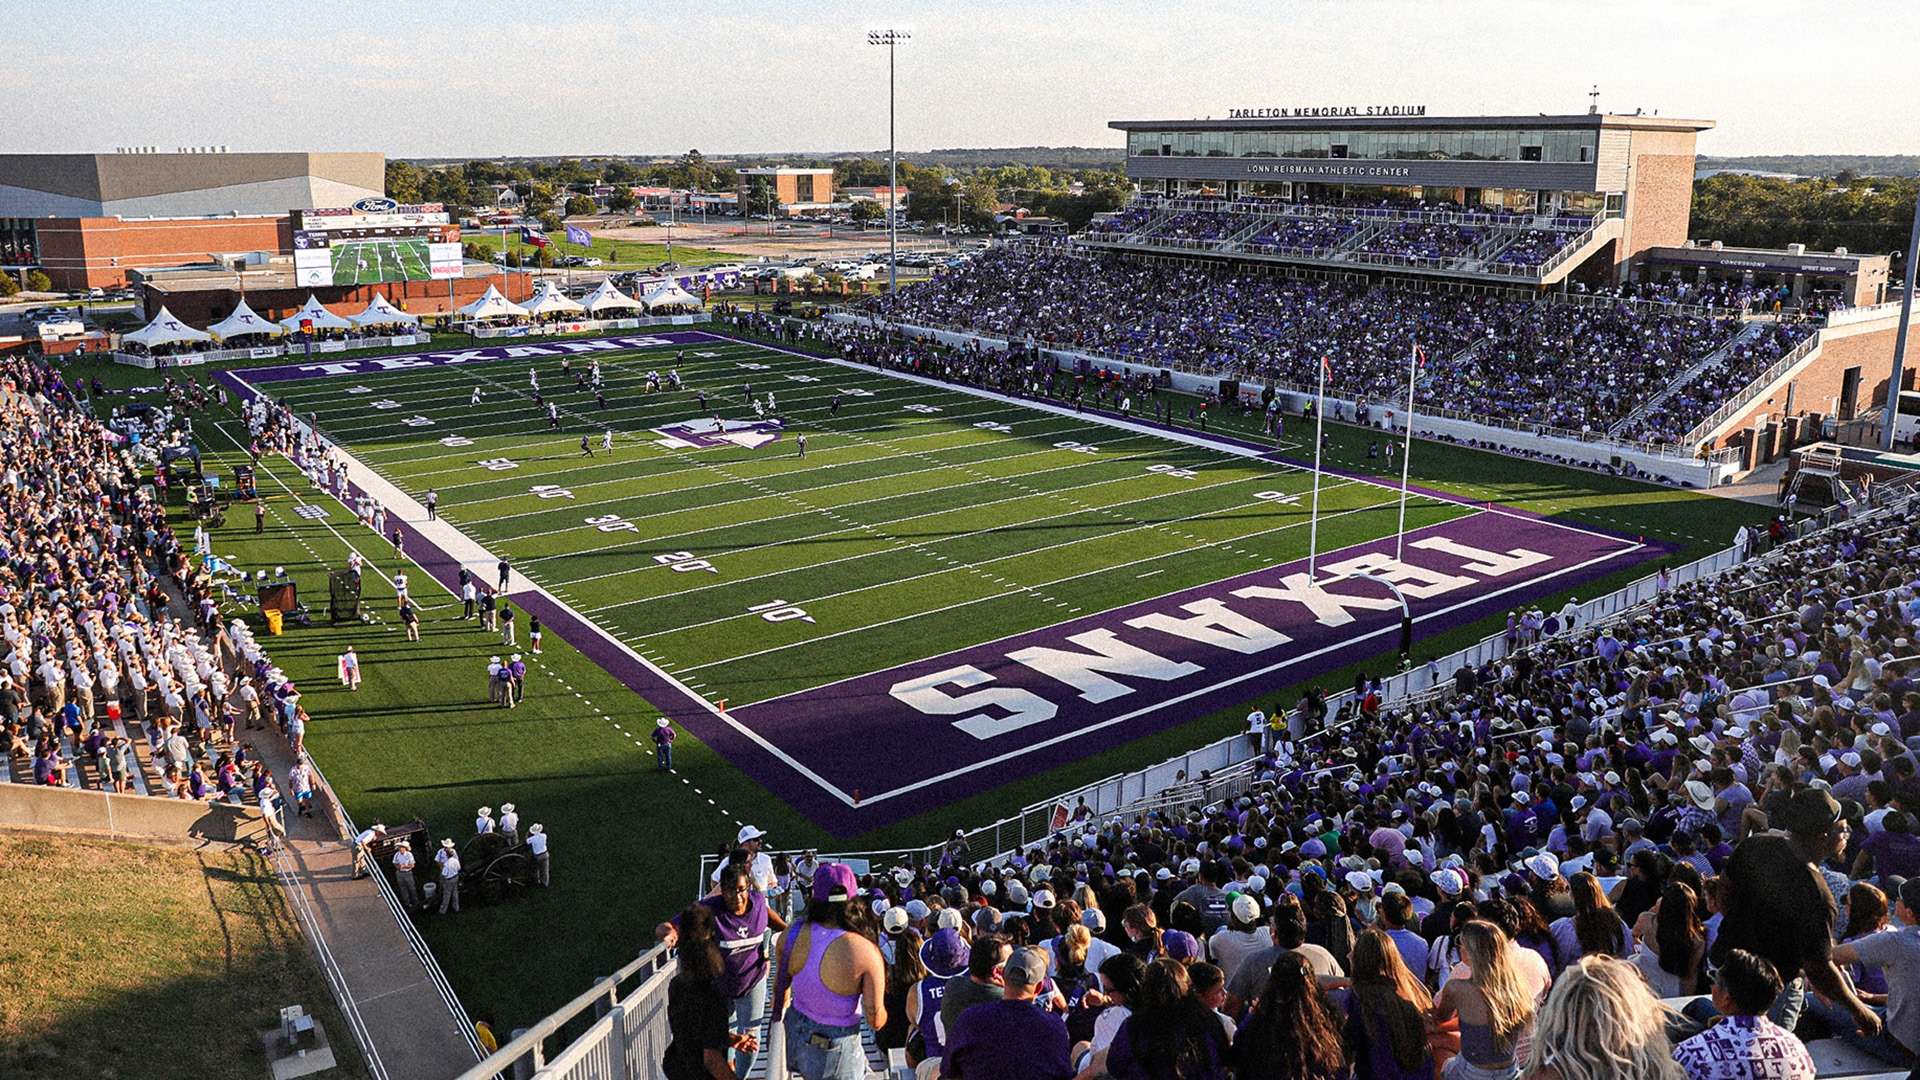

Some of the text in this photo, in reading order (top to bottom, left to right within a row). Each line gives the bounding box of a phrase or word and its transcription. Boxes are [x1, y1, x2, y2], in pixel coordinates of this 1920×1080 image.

[1229, 105, 1426, 119] TARLETON MEMORIAL STADIUM
[1247, 164, 1410, 177] LONN REISMAN ATHLETIC CENTER
[363, 200, 390, 211] Ford
[1720, 259, 1766, 268] CONCESSIONS
[300, 336, 674, 375] TEXANS
[584, 514, 636, 533] 30
[652, 551, 712, 573] 20
[747, 599, 807, 623] 10
[889, 536, 1553, 740] TEXANS
